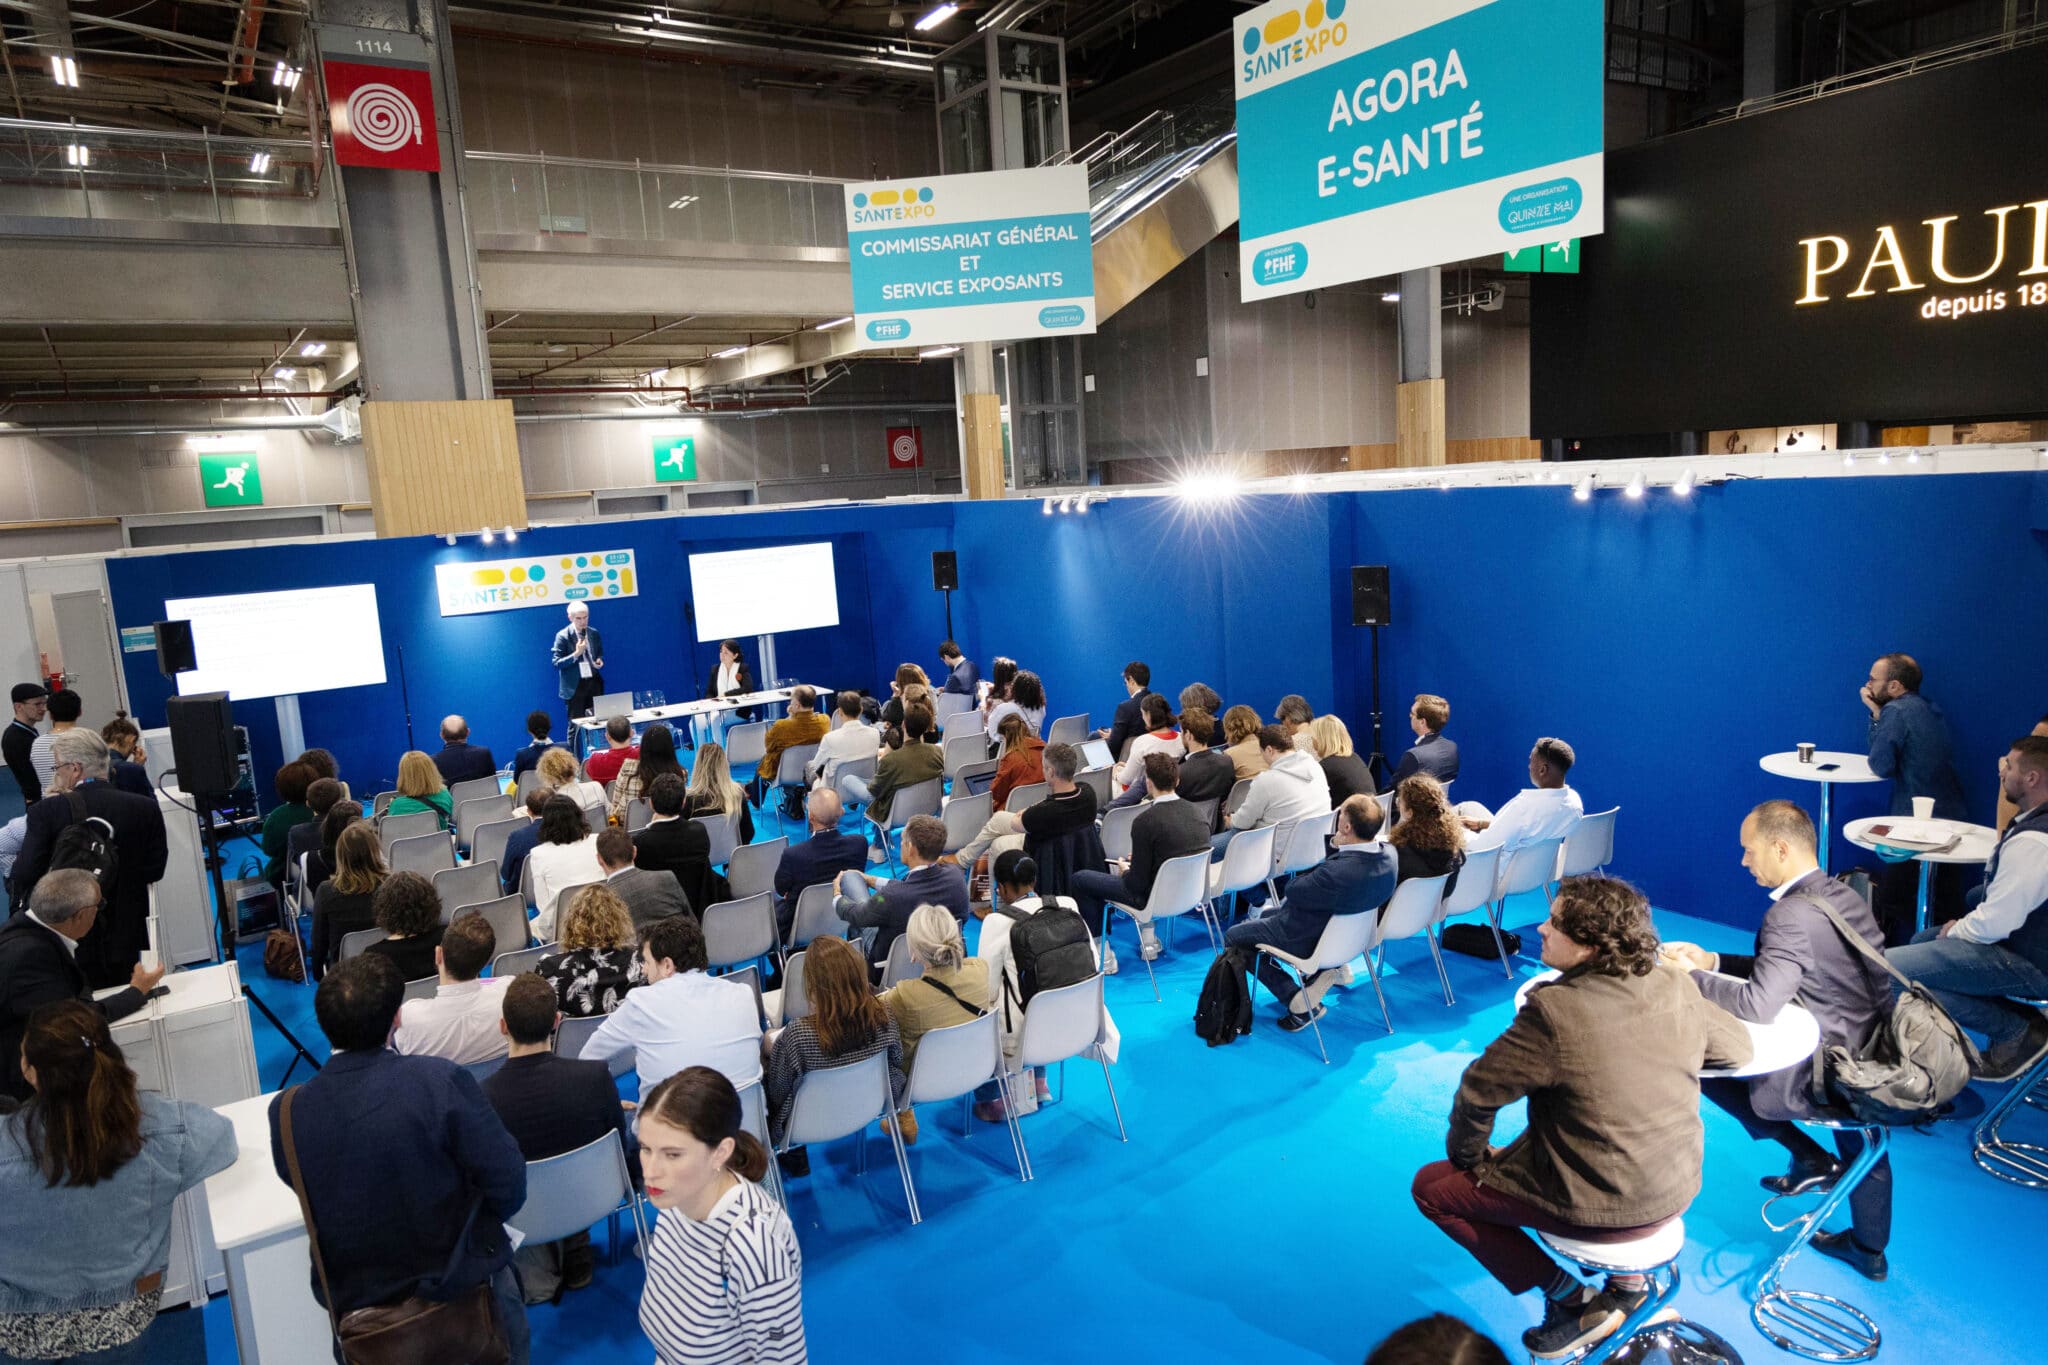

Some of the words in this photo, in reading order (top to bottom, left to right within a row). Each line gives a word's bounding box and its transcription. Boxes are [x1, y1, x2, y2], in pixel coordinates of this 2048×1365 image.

[355, 39, 393, 54] 1114
[1243, 21, 1348, 83] SANTEXPO
[1327, 48, 1468, 133] AGORA
[1317, 99, 1484, 198] E-SANTÉ
[1509, 195, 1522, 204] UNE
[1522, 184, 1569, 200] ORGANISATION
[854, 204, 936, 224] SANTEXPO
[1507, 203, 1552, 224] QUINZE
[1553, 198, 1574, 214] MAI
[861, 231, 992, 257] COMMISSARIAT
[997, 223, 1079, 246] GÉNÉRAL
[959, 255, 981, 272] ET
[1272, 253, 1296, 275] FHF
[882, 279, 954, 300] SERVICE
[958, 271, 1064, 294] EXPOSANTS
[1921, 288, 2007, 320] depuis
[2017, 281, 2048, 306] 18
[449, 583, 549, 607] SANTEXPO
